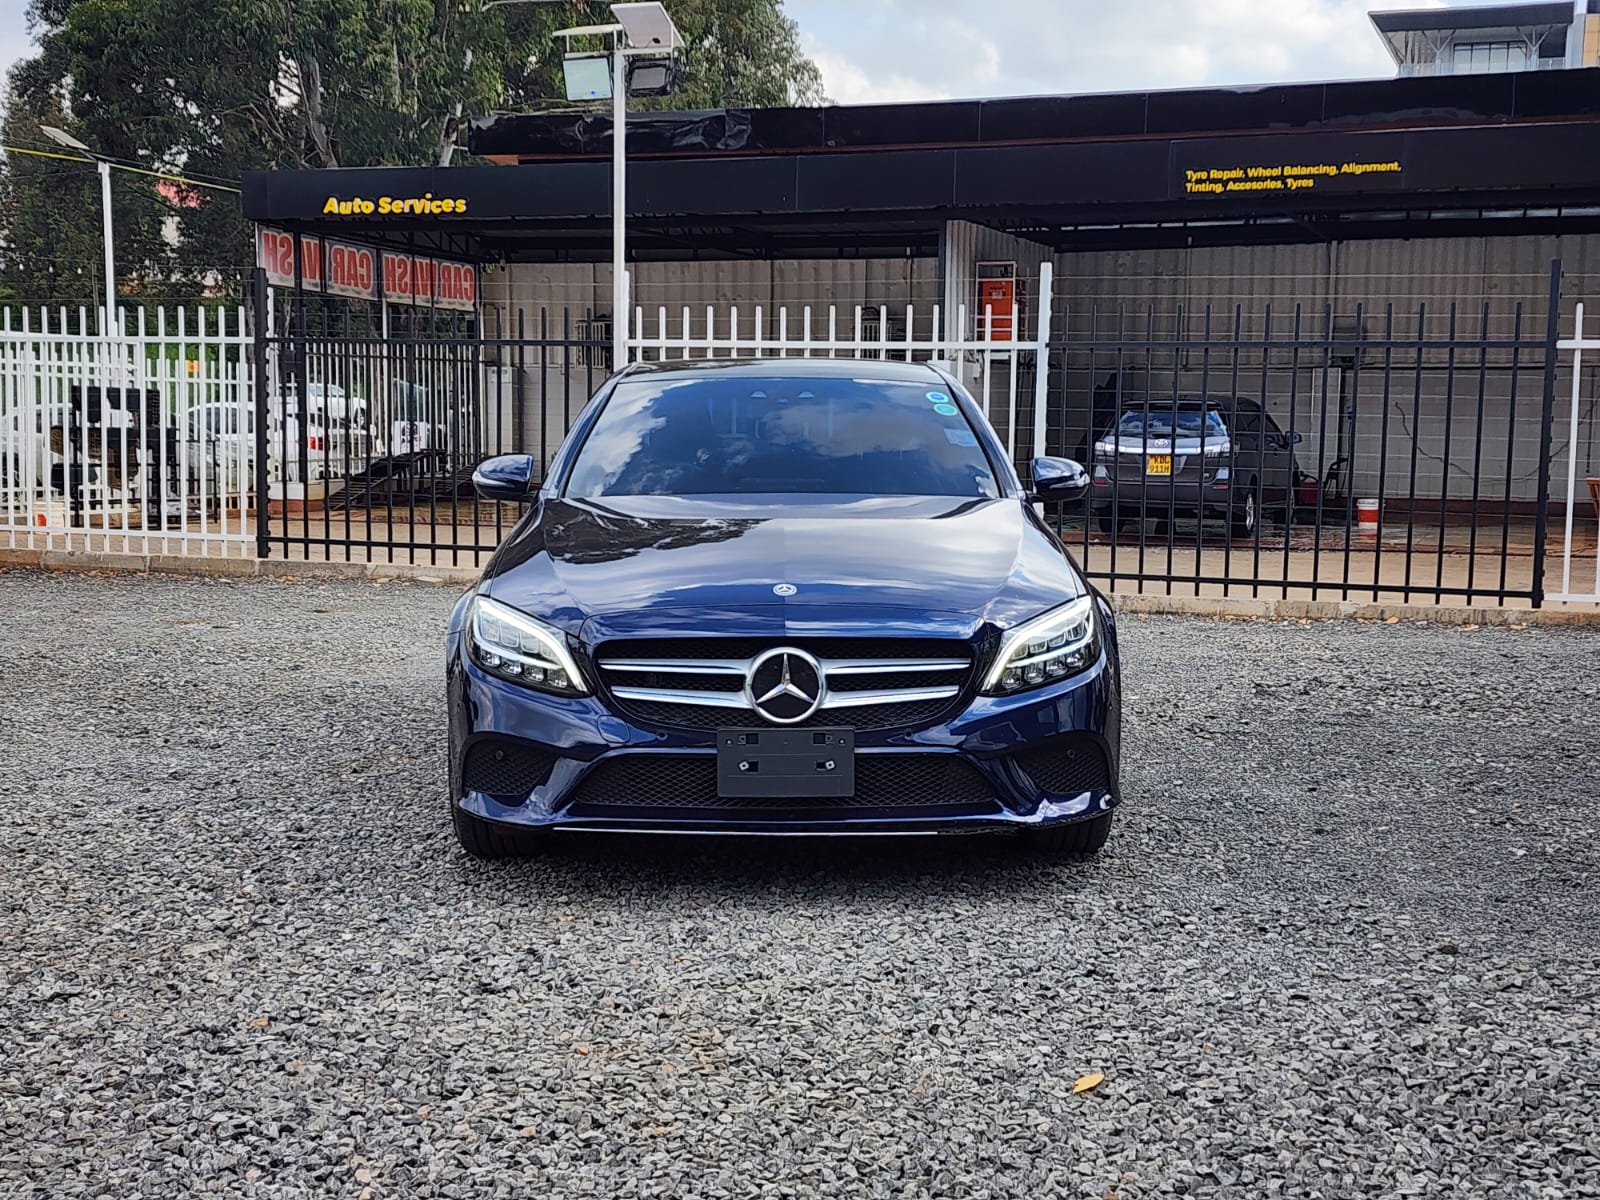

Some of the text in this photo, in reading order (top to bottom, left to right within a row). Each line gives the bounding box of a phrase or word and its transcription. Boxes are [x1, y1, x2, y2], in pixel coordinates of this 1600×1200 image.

[1185, 161, 1402, 182] Tyre Repair, Wheel Balancing, Alignment,
[1185, 178, 1314, 194] Tinting, Accesories, Tyres
[322, 192, 467, 215] Auto Services
